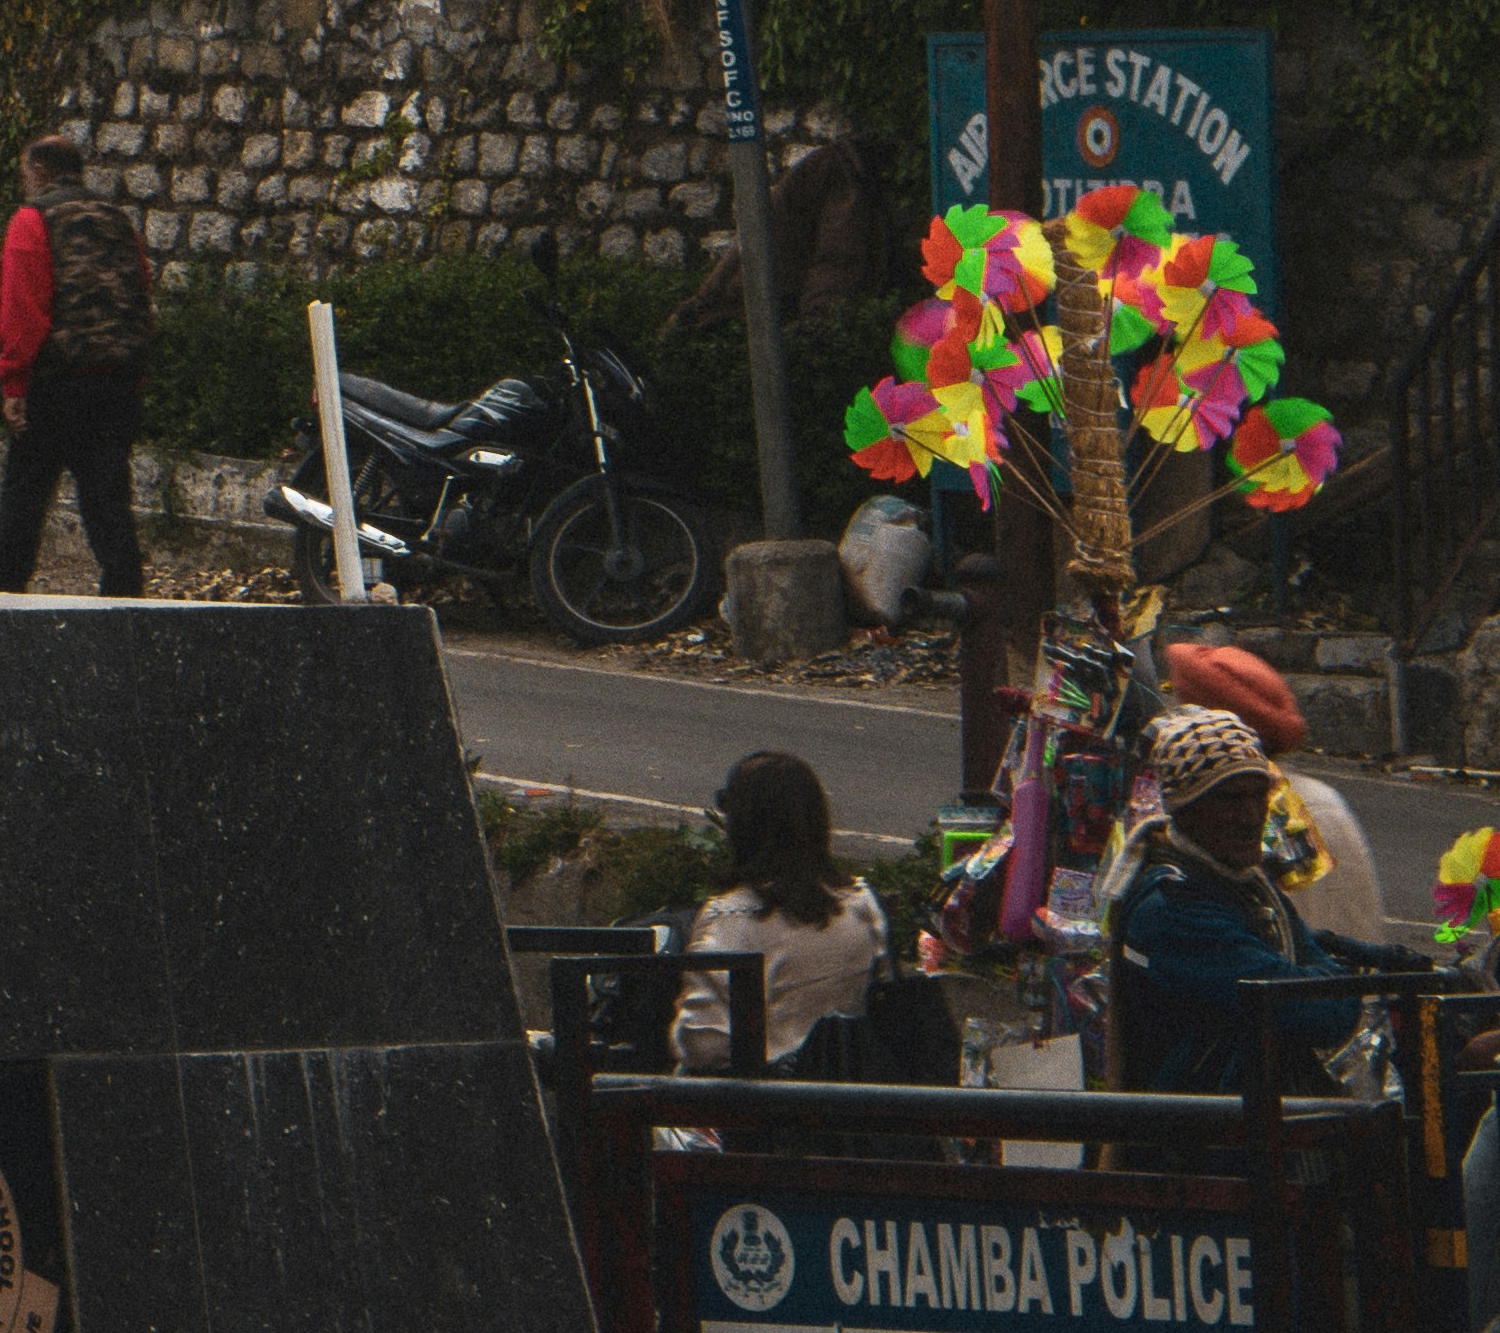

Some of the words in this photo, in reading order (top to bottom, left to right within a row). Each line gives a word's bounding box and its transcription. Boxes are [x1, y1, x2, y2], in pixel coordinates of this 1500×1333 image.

[1038, 47, 1098, 110] RCE
[1105, 47, 1252, 186] STATION
[829, 1217, 1055, 1316] CHAMBA
[1065, 1228, 1256, 1326] POLICE
